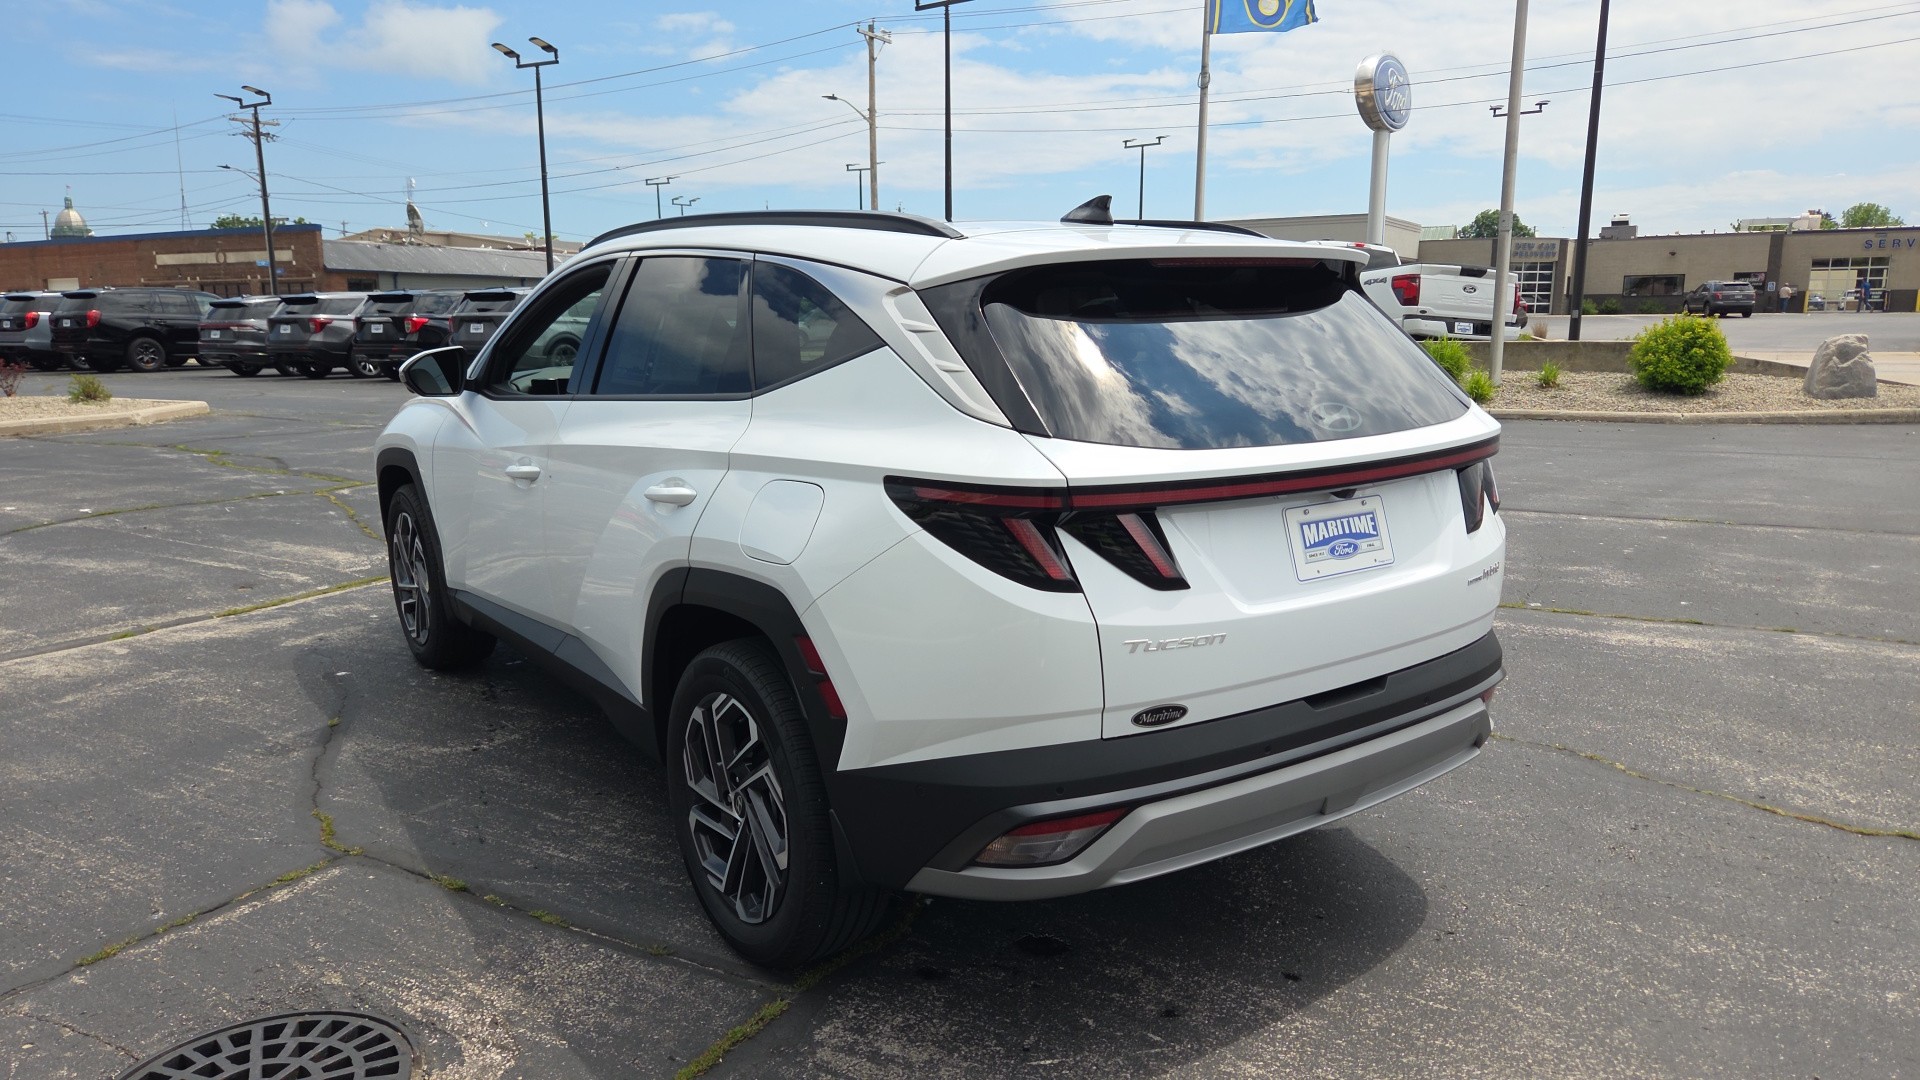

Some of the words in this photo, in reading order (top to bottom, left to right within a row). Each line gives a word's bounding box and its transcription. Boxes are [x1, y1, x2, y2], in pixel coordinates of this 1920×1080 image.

[1864, 238, 1916, 249] SERV
[1302, 514, 1377, 547] MARITIME
[1334, 542, 1354, 556] Ford
[1139, 708, 1183, 724] Maritime
